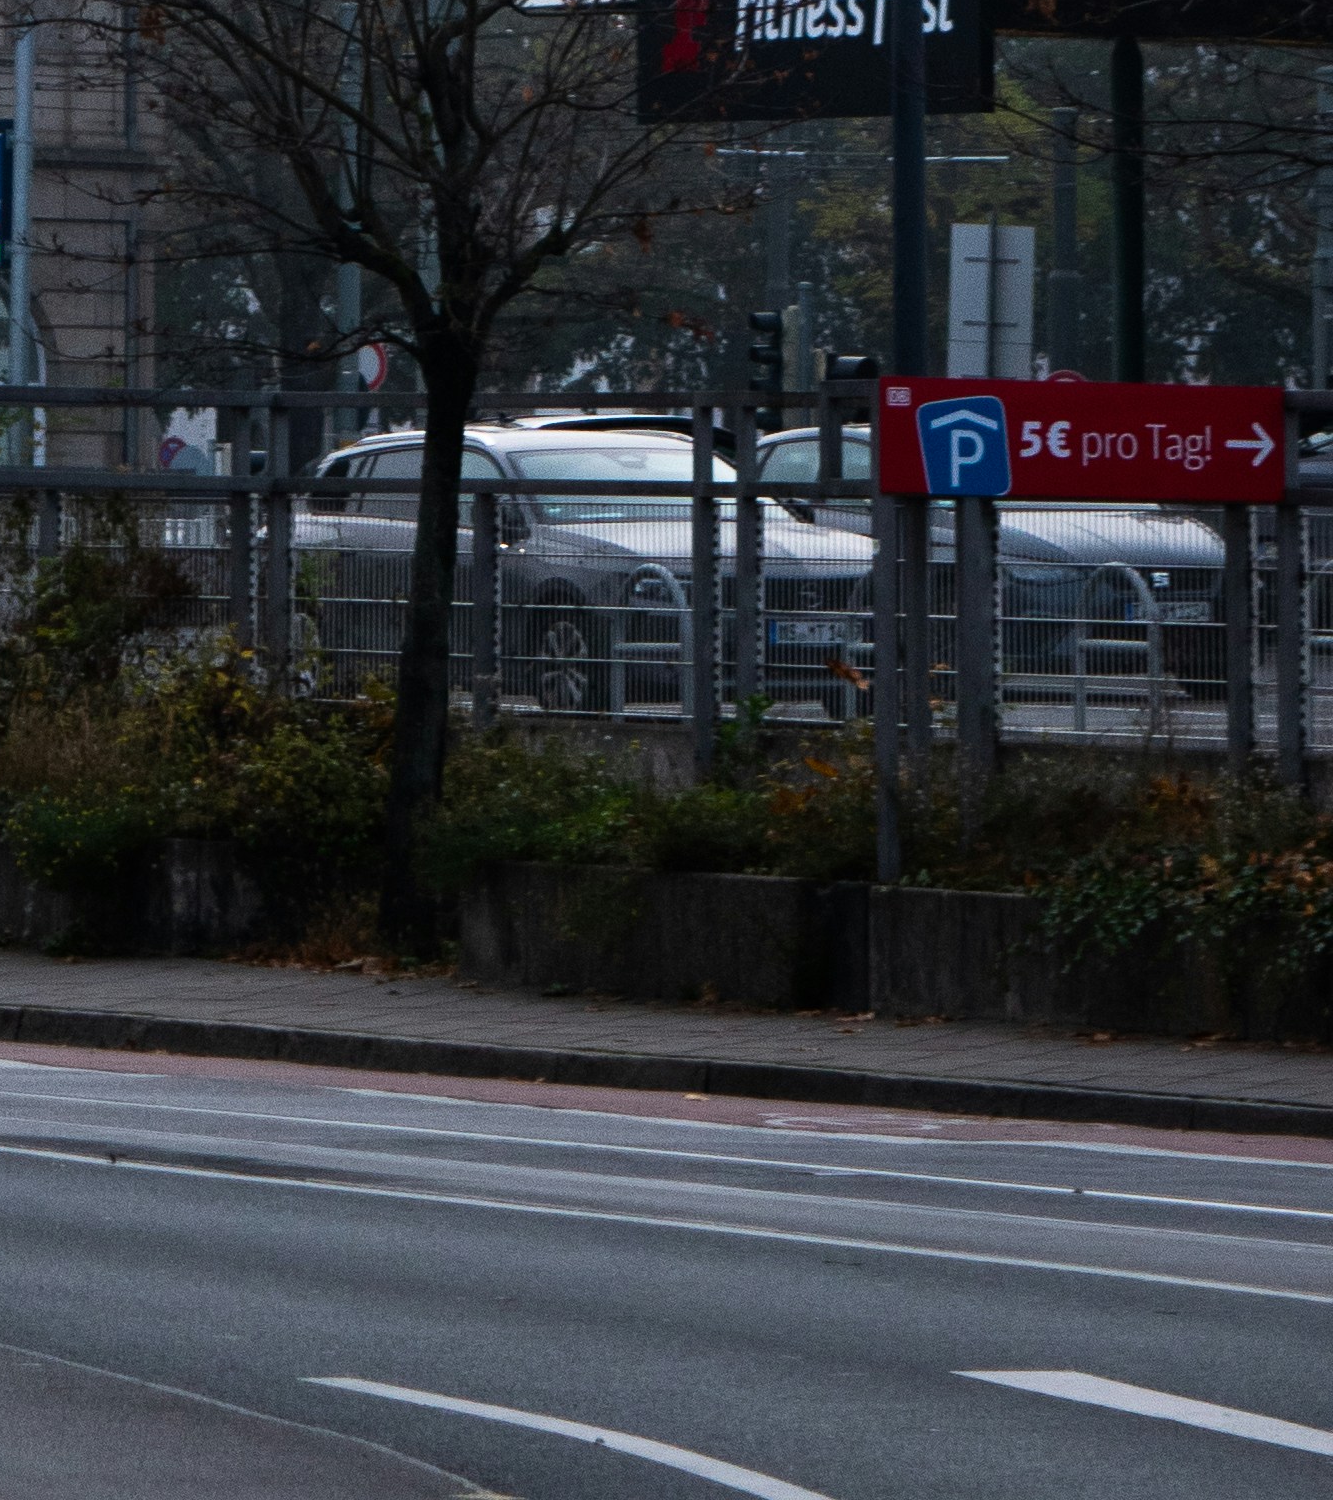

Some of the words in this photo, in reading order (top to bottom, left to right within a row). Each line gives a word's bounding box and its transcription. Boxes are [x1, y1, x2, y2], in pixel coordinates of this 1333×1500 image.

[951, 430, 985, 487] P
[1019, 421, 1073, 459] 5€
[1082, 431, 1138, 467] pro
[1145, 423, 1212, 471] Tag!
